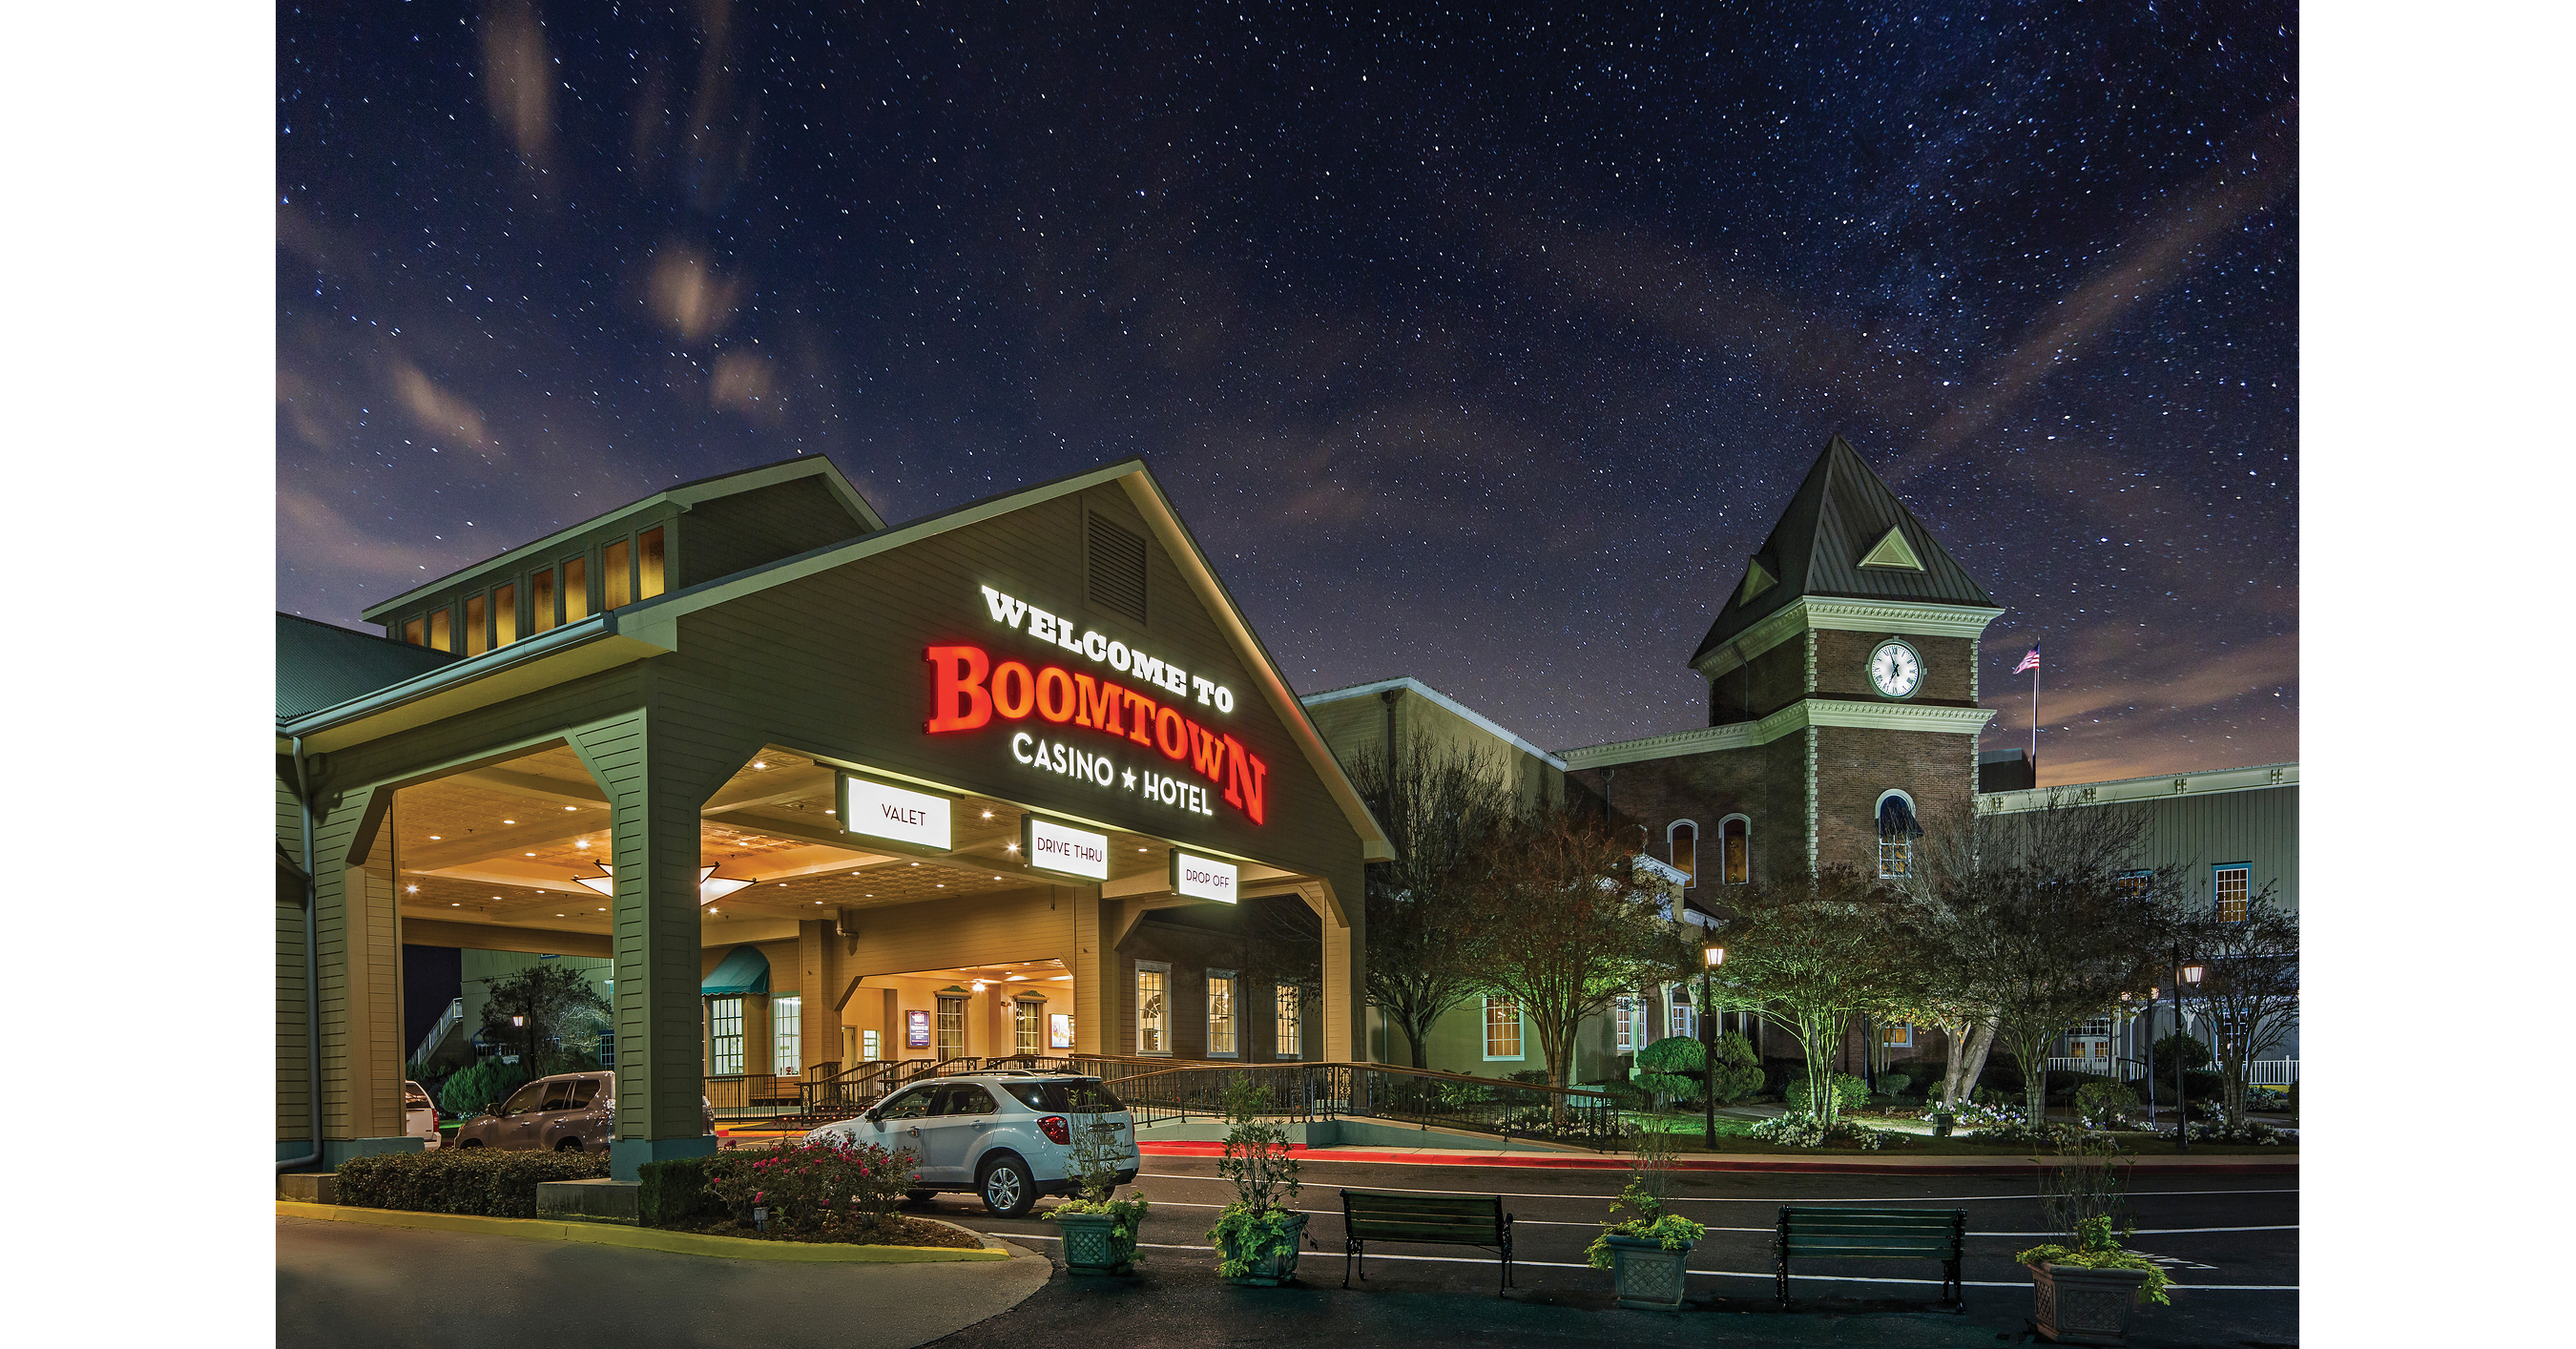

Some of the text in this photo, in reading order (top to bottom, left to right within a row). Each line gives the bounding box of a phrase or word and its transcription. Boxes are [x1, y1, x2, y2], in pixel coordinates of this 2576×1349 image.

[982, 584, 1234, 713] WELCOME TO
[924, 645, 1267, 826] BOOMTOWN
[1012, 732, 1213, 816] CASINO HOTEL
[881, 802, 926, 826] VALET
[1037, 837, 1103, 862] DRIVE THRU
[1186, 868, 1230, 888] DROP OFF
